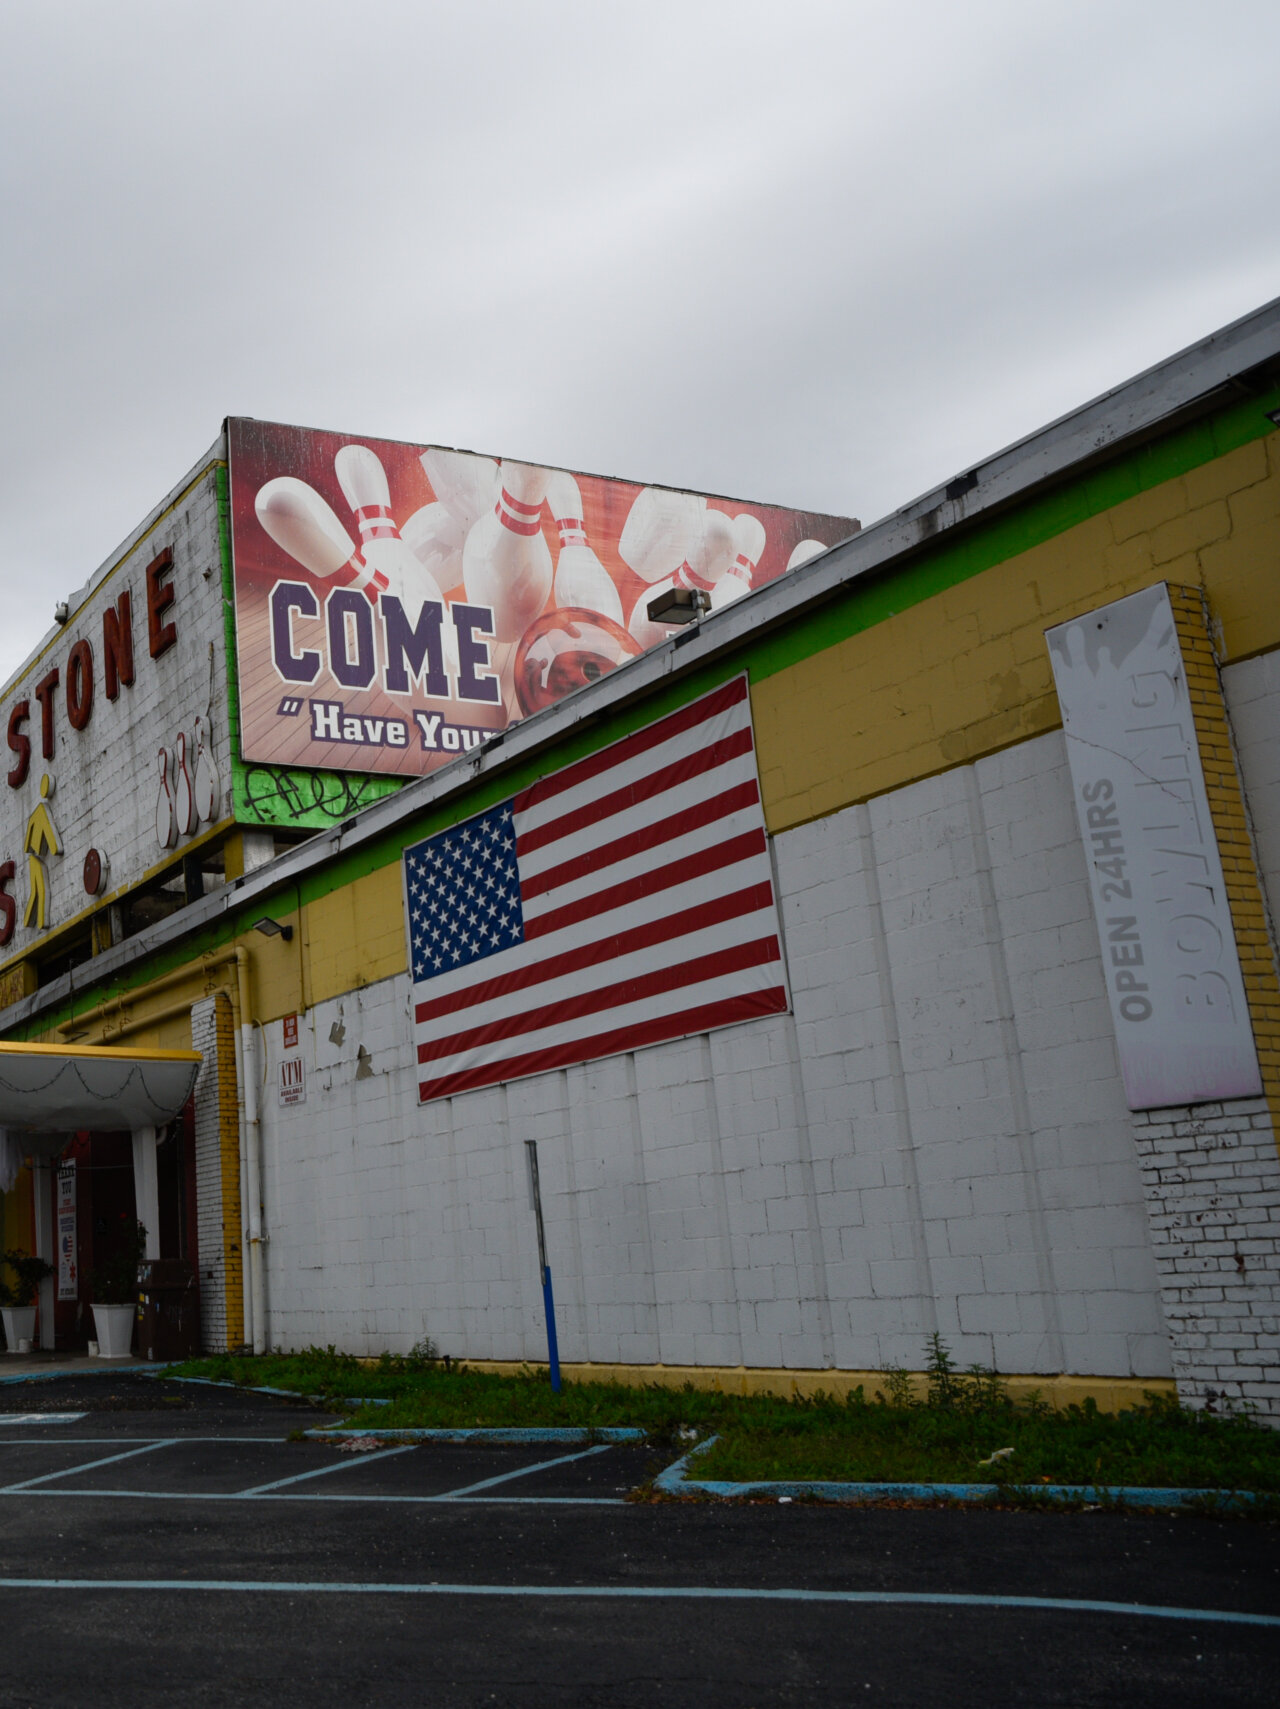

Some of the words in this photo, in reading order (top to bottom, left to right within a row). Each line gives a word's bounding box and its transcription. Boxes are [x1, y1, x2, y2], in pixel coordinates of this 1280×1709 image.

[269, 579, 502, 705] COME
[313, 703, 406, 746] Have
[1083, 778, 1131, 902] 24HRS
[1110, 915, 1153, 1023] OPEN
[280, 1059, 303, 1087] ATM
[280, 1087, 303, 1097] AVAILABLE
